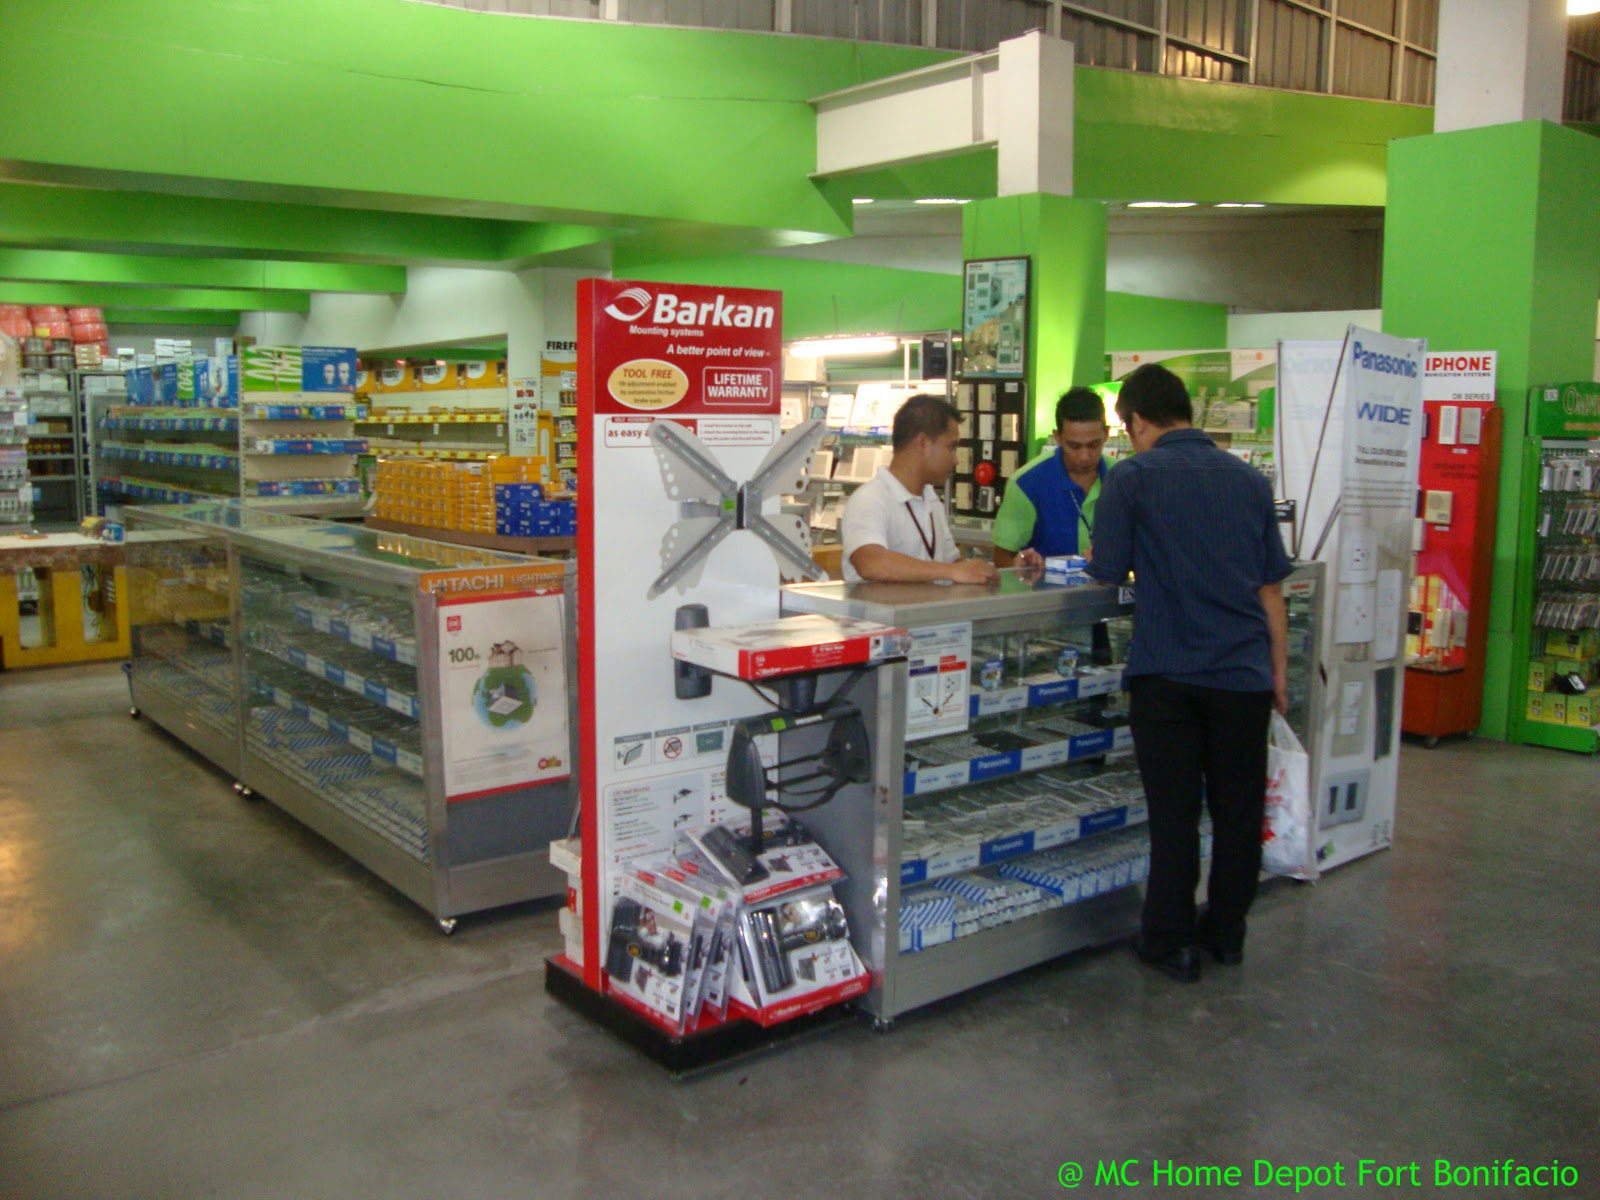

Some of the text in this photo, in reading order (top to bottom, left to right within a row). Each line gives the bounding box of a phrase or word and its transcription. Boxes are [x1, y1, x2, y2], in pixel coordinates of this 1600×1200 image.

[653, 293, 775, 328] Barkan
[629, 325, 704, 338] Mounting systems
[666, 344, 765, 358] A better point of view
[1353, 341, 1418, 378] Panasonic
[1425, 356, 1492, 371] IPHONE
[623, 368, 673, 379] TOOL FREE
[714, 373, 762, 385] LIFETIME
[707, 386, 768, 398] WARRANTY
[1356, 402, 1412, 426] WIDE
[620, 429, 642, 439] easy
[428, 572, 557, 592] HITACHI LIGHTING
[978, 757, 1012, 770] Panasonic
